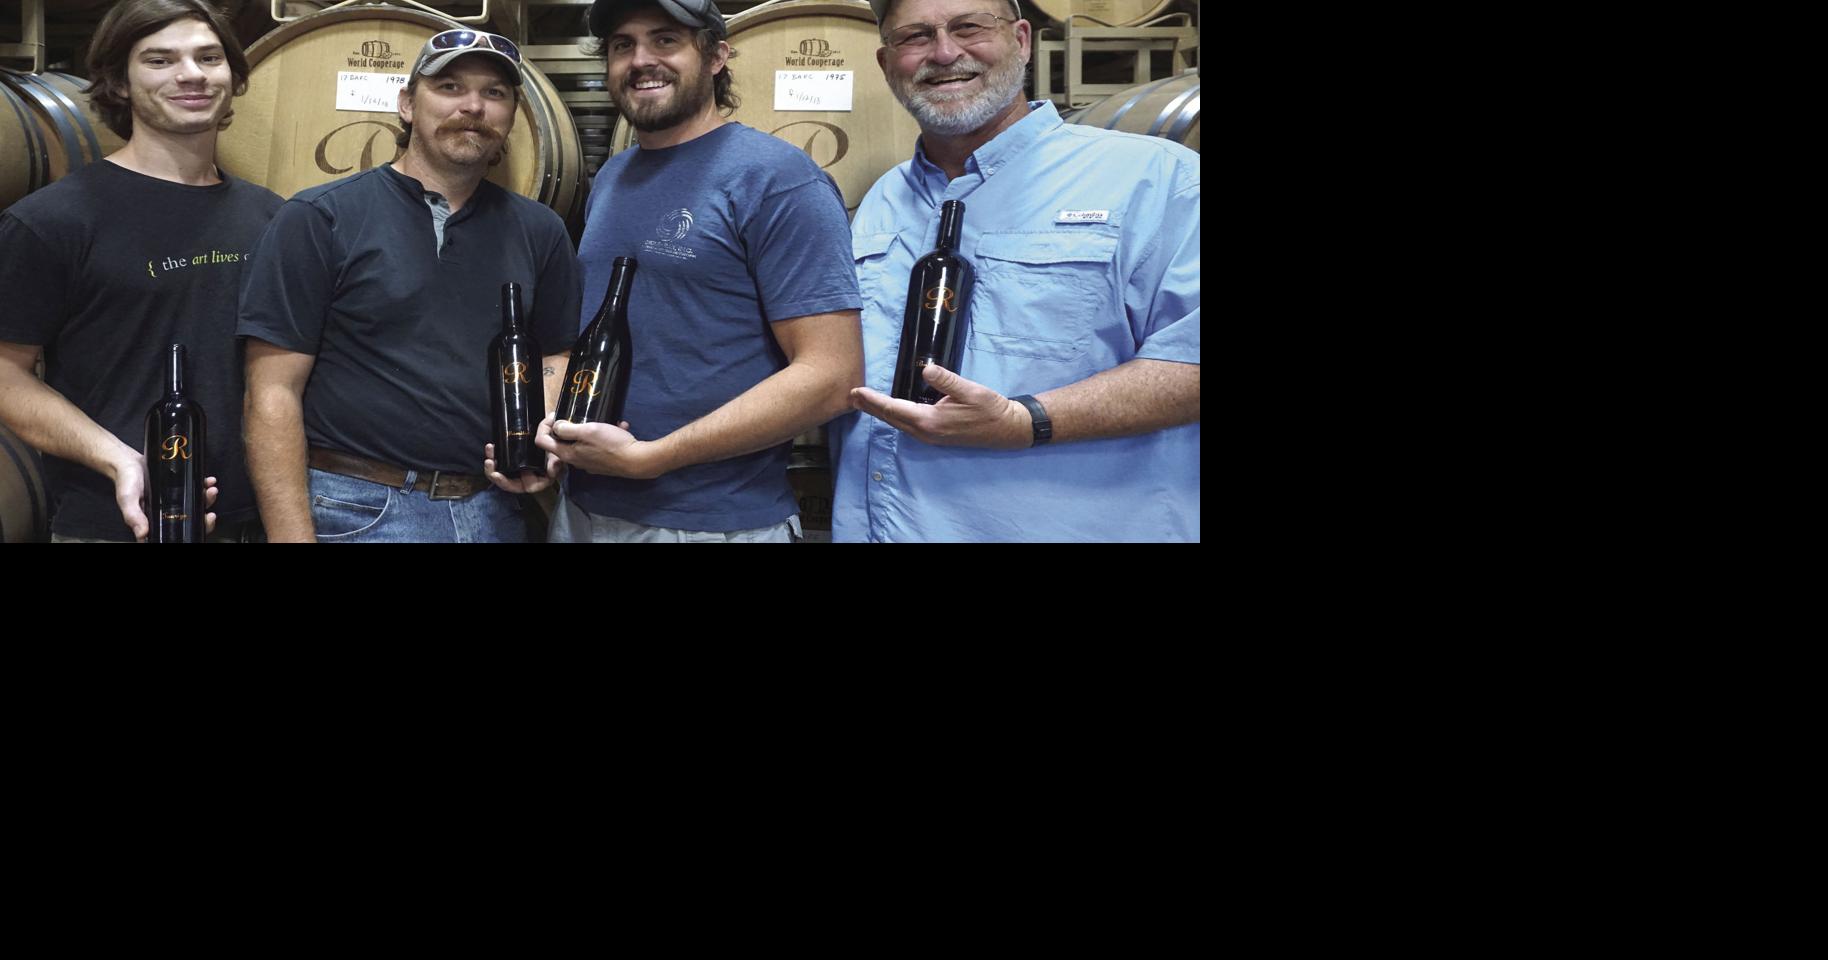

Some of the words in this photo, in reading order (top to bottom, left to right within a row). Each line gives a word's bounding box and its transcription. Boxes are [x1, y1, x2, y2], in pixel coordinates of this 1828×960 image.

[347, 58, 367, 68] World
[368, 59, 405, 69] Cooperage
[785, 57, 806, 67] World
[807, 57, 845, 68] Cooperage
[385, 76, 406, 84] 1978
[825, 73, 846, 81] 1975
[162, 256, 187, 271] the
[192, 254, 208, 265] art
[211, 250, 239, 263] lives
[504, 361, 530, 384] R
[570, 369, 600, 397] R
[162, 435, 192, 460] R
